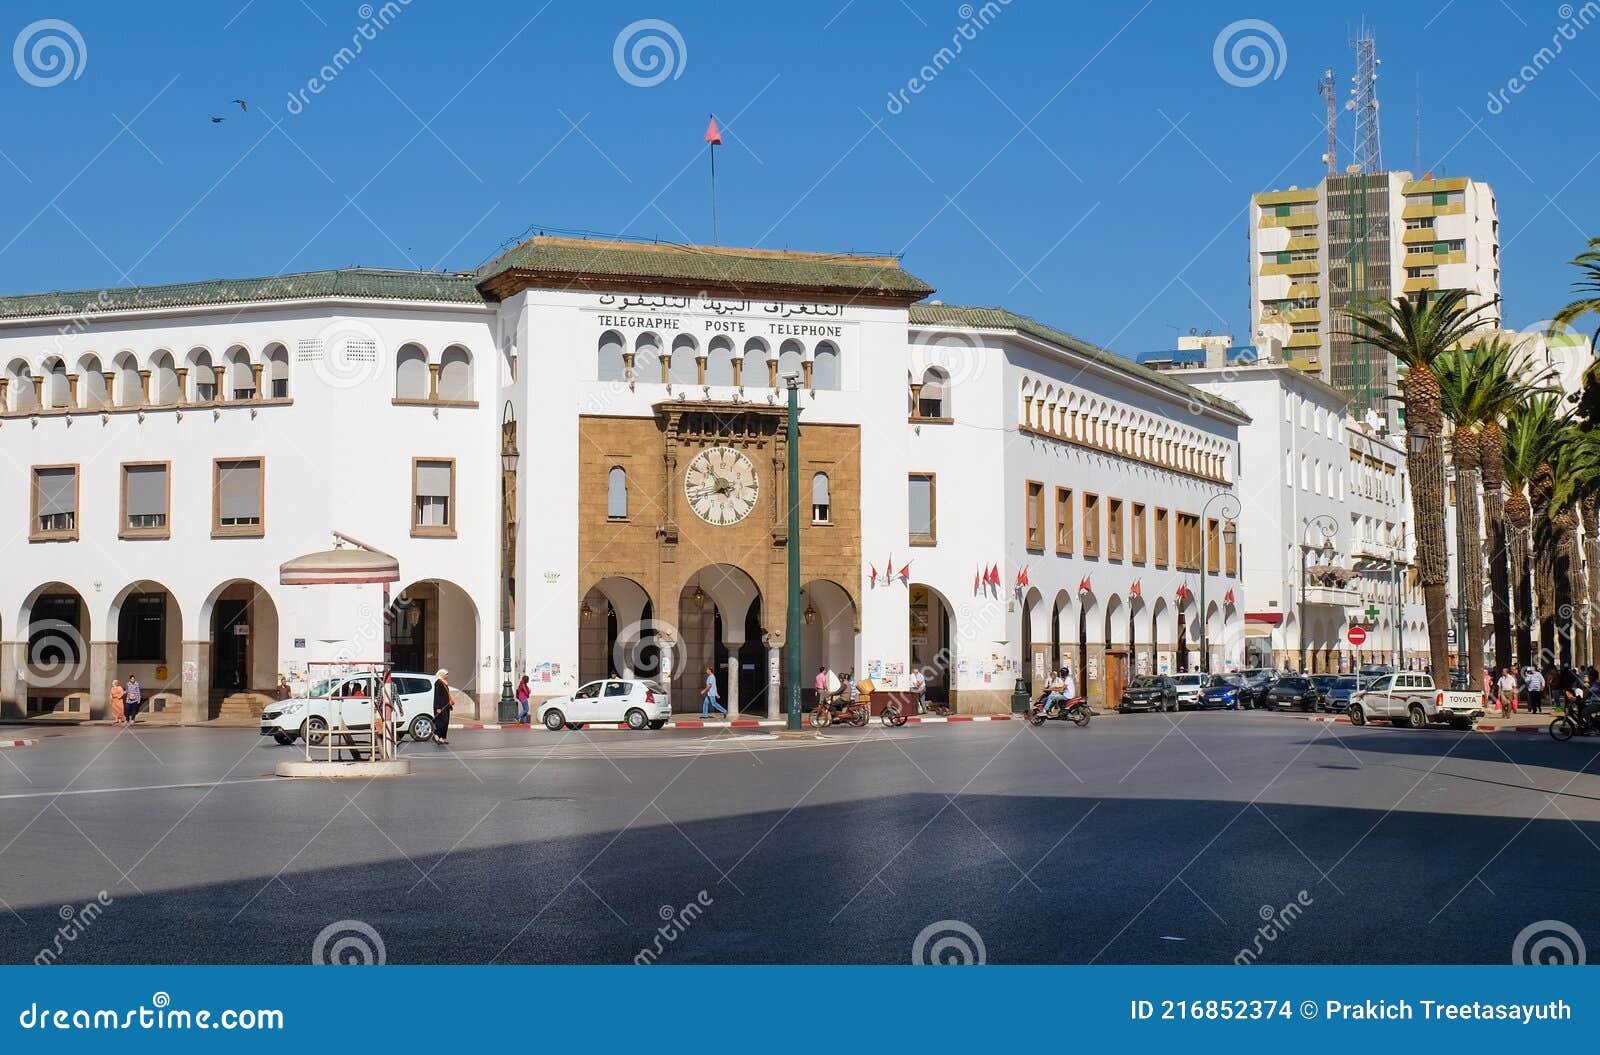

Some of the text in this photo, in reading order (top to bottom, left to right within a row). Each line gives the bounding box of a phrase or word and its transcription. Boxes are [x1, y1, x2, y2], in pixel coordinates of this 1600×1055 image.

[597, 315, 841, 337] TELEGRAPHE POSTE TELEPHONE
